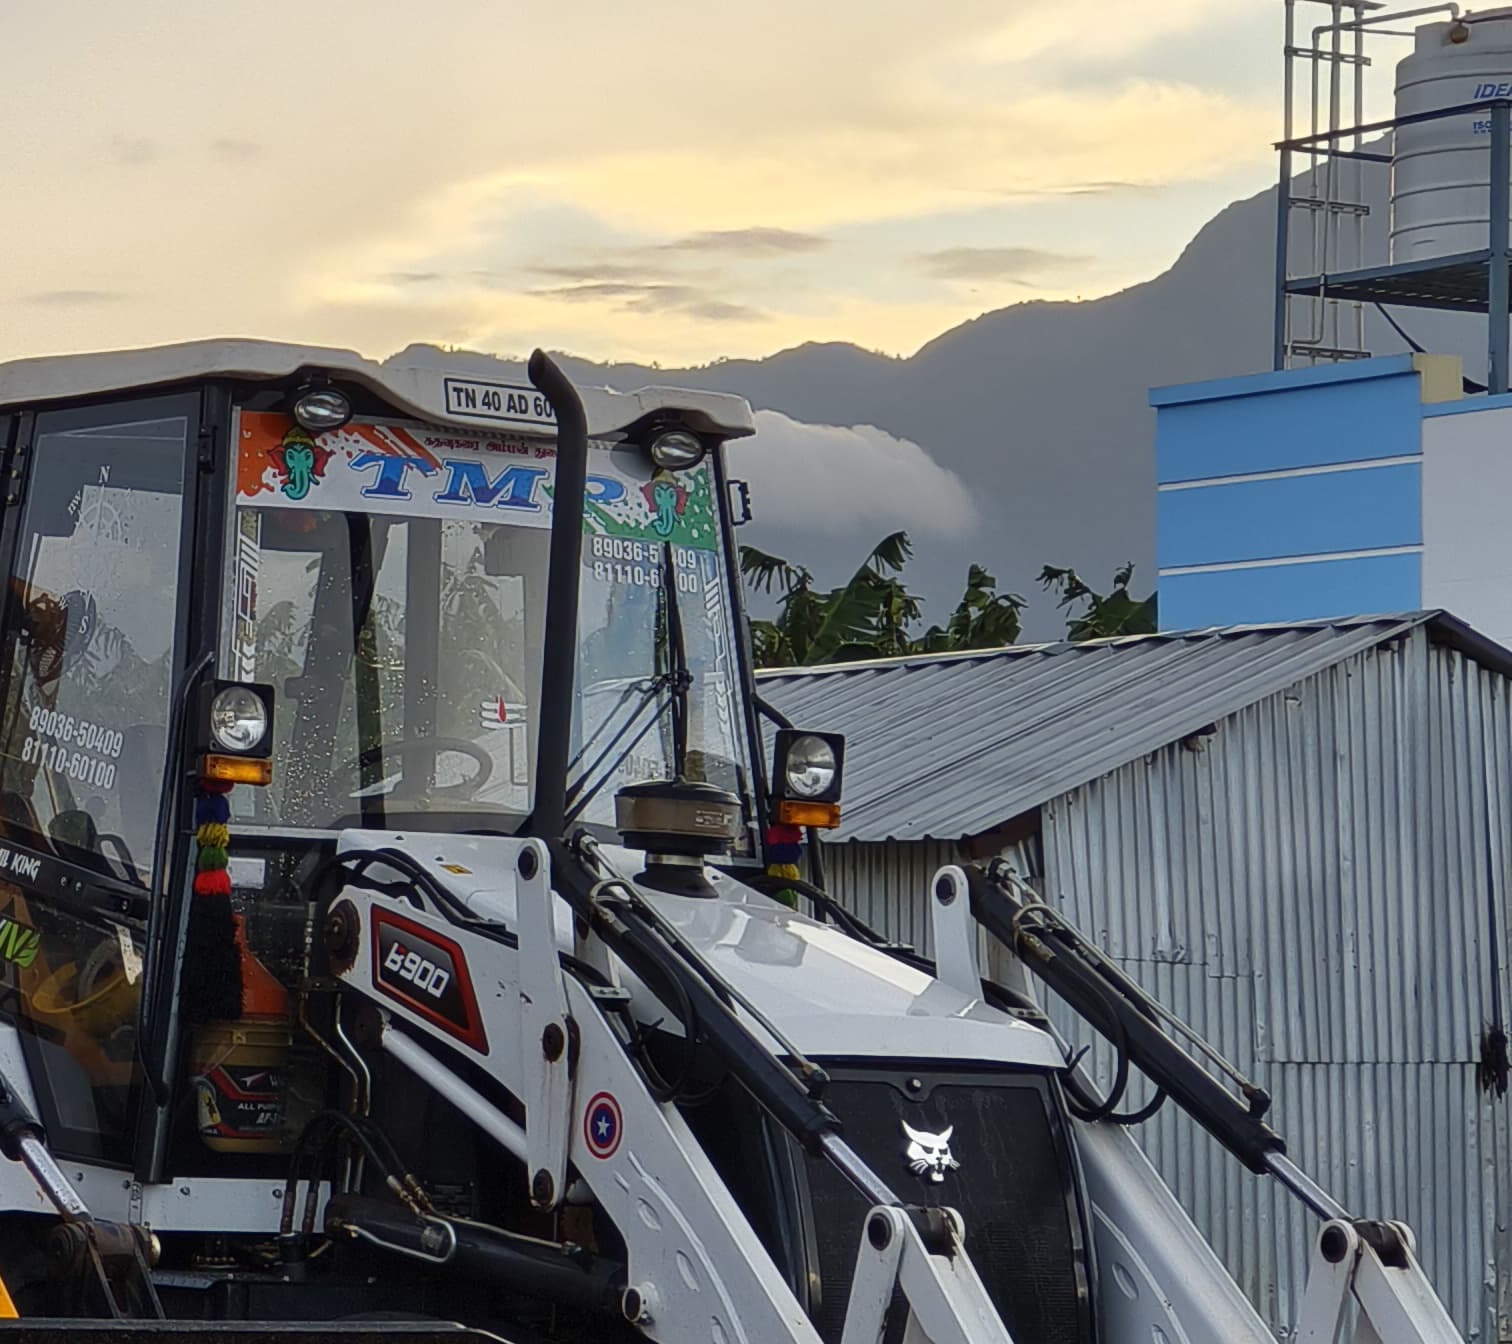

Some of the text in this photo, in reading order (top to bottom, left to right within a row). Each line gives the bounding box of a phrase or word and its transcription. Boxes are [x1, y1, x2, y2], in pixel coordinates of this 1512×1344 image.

[452, 386, 477, 409] TN
[481, 389, 502, 412] 40
[507, 392, 529, 415] AD
[593, 537, 696, 569] 89036-509
[594, 561, 697, 592] 81110-600
[29, 706, 124, 758] 89036-50409
[22, 736, 116, 789] 81110-60100
[10, 853, 42, 883] KING
